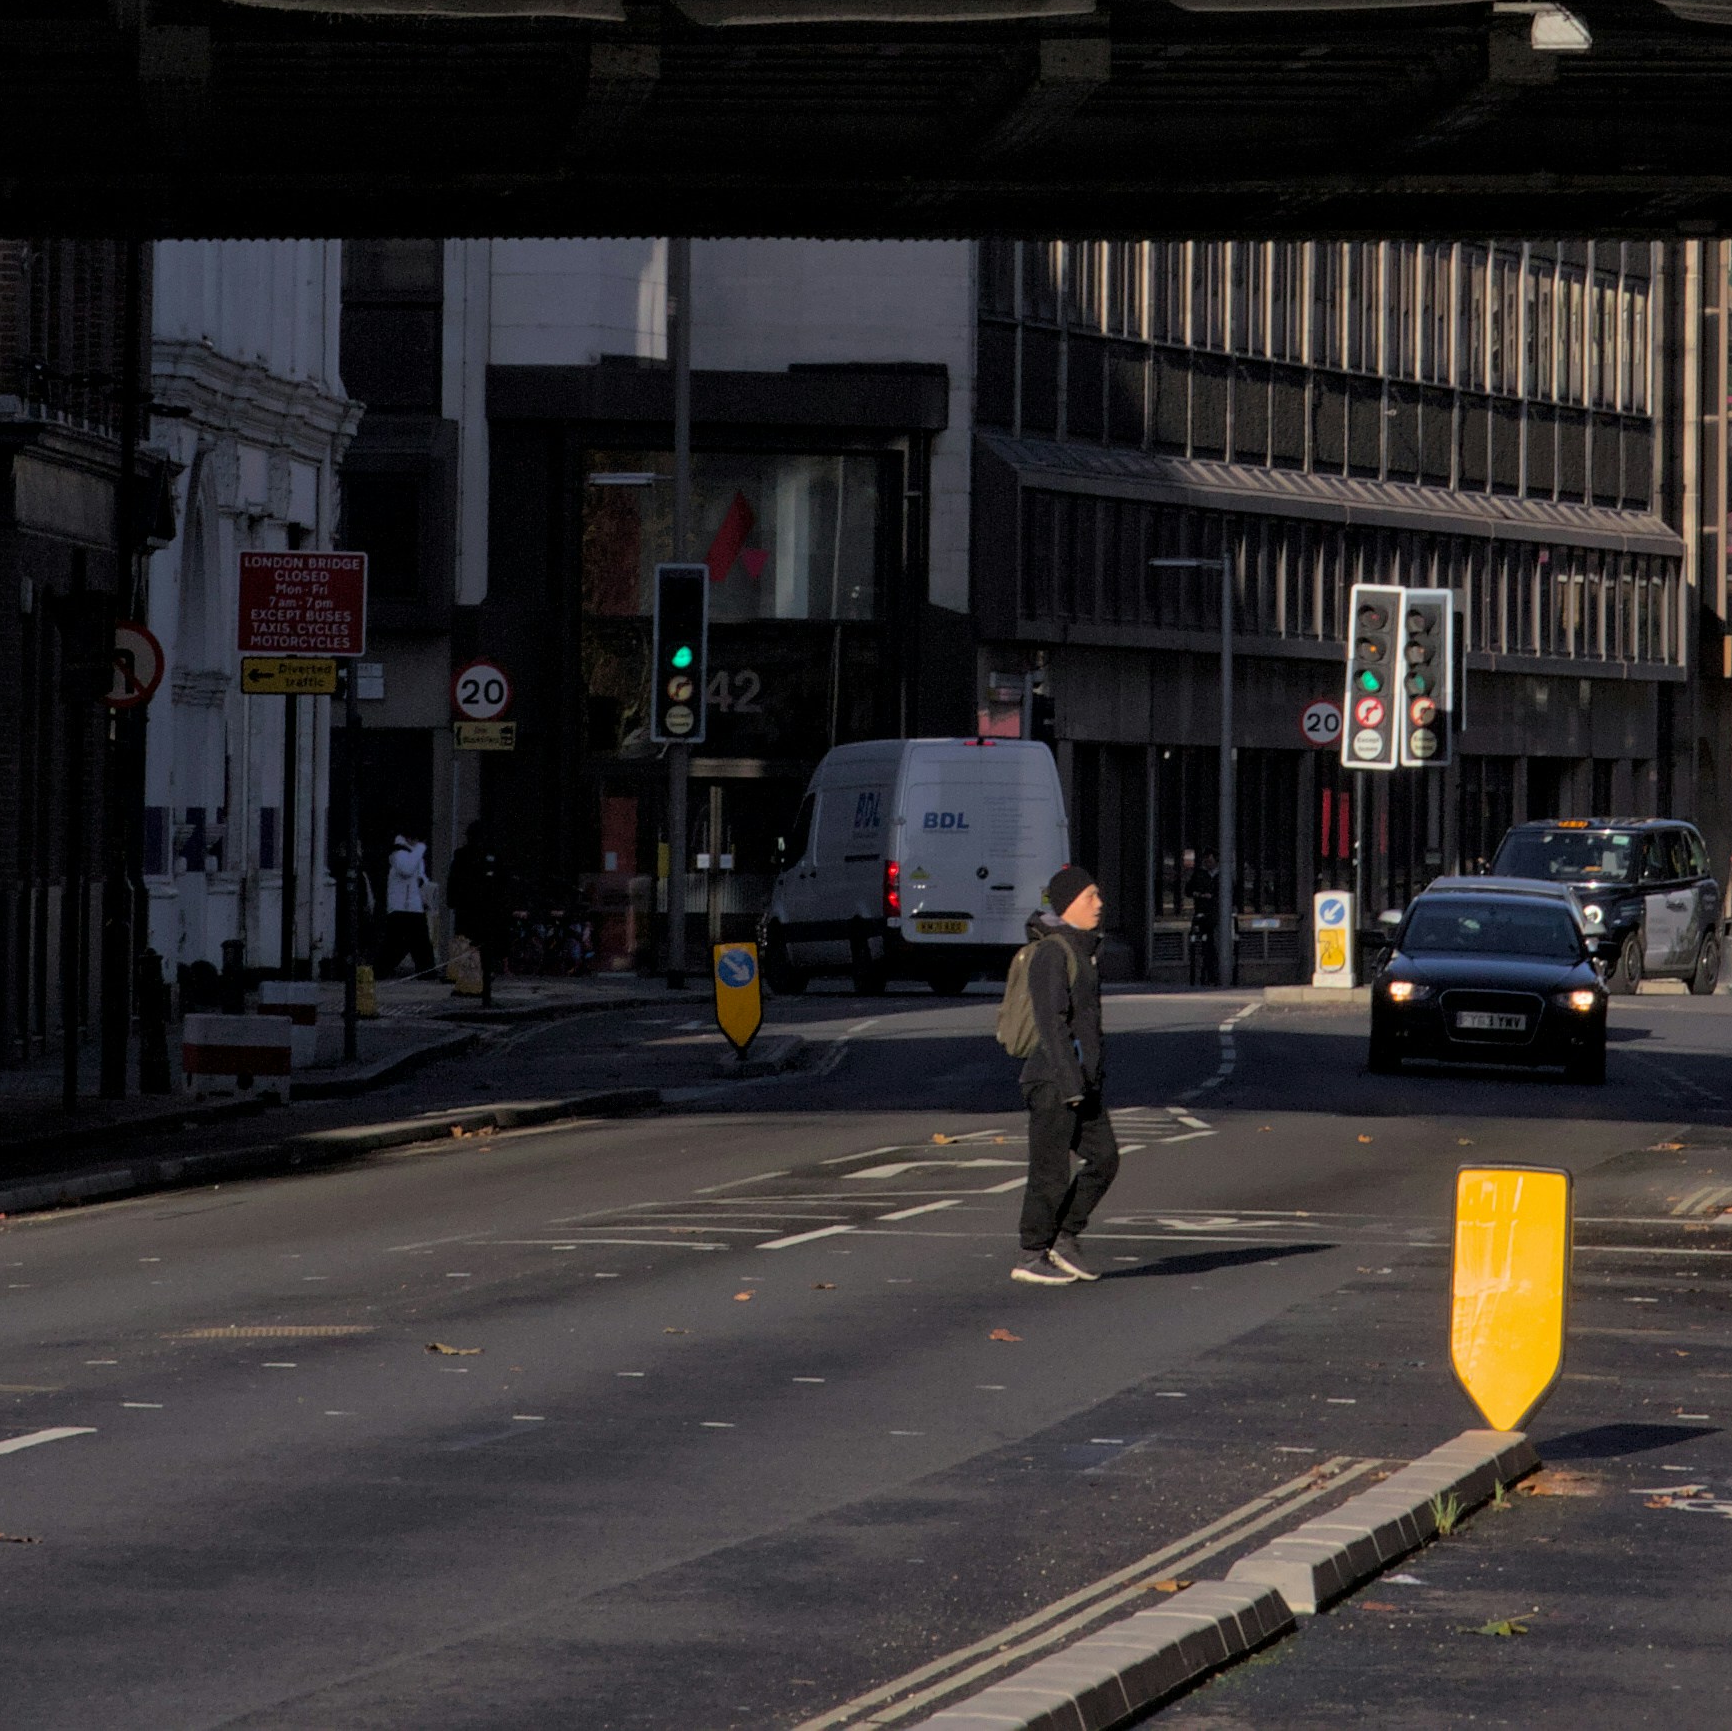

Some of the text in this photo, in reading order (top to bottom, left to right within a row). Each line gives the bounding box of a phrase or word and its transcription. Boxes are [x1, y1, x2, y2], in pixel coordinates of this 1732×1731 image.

[244, 556, 361, 570] LONDON BRIDGE
[274, 570, 330, 583] CLOSED
[275, 583, 304, 596] Mon
[311, 584, 329, 596] Fri
[250, 610, 352, 623] EXCEPT BUSES
[297, 623, 349, 636] CYCLES
[250, 635, 351, 649] MOTORCYCLES
[278, 663, 333, 675] Diverted
[285, 676, 326, 688] traffic
[461, 679, 504, 705] 20
[1307, 712, 1341, 733] 20
[922, 811, 970, 830] BDL
